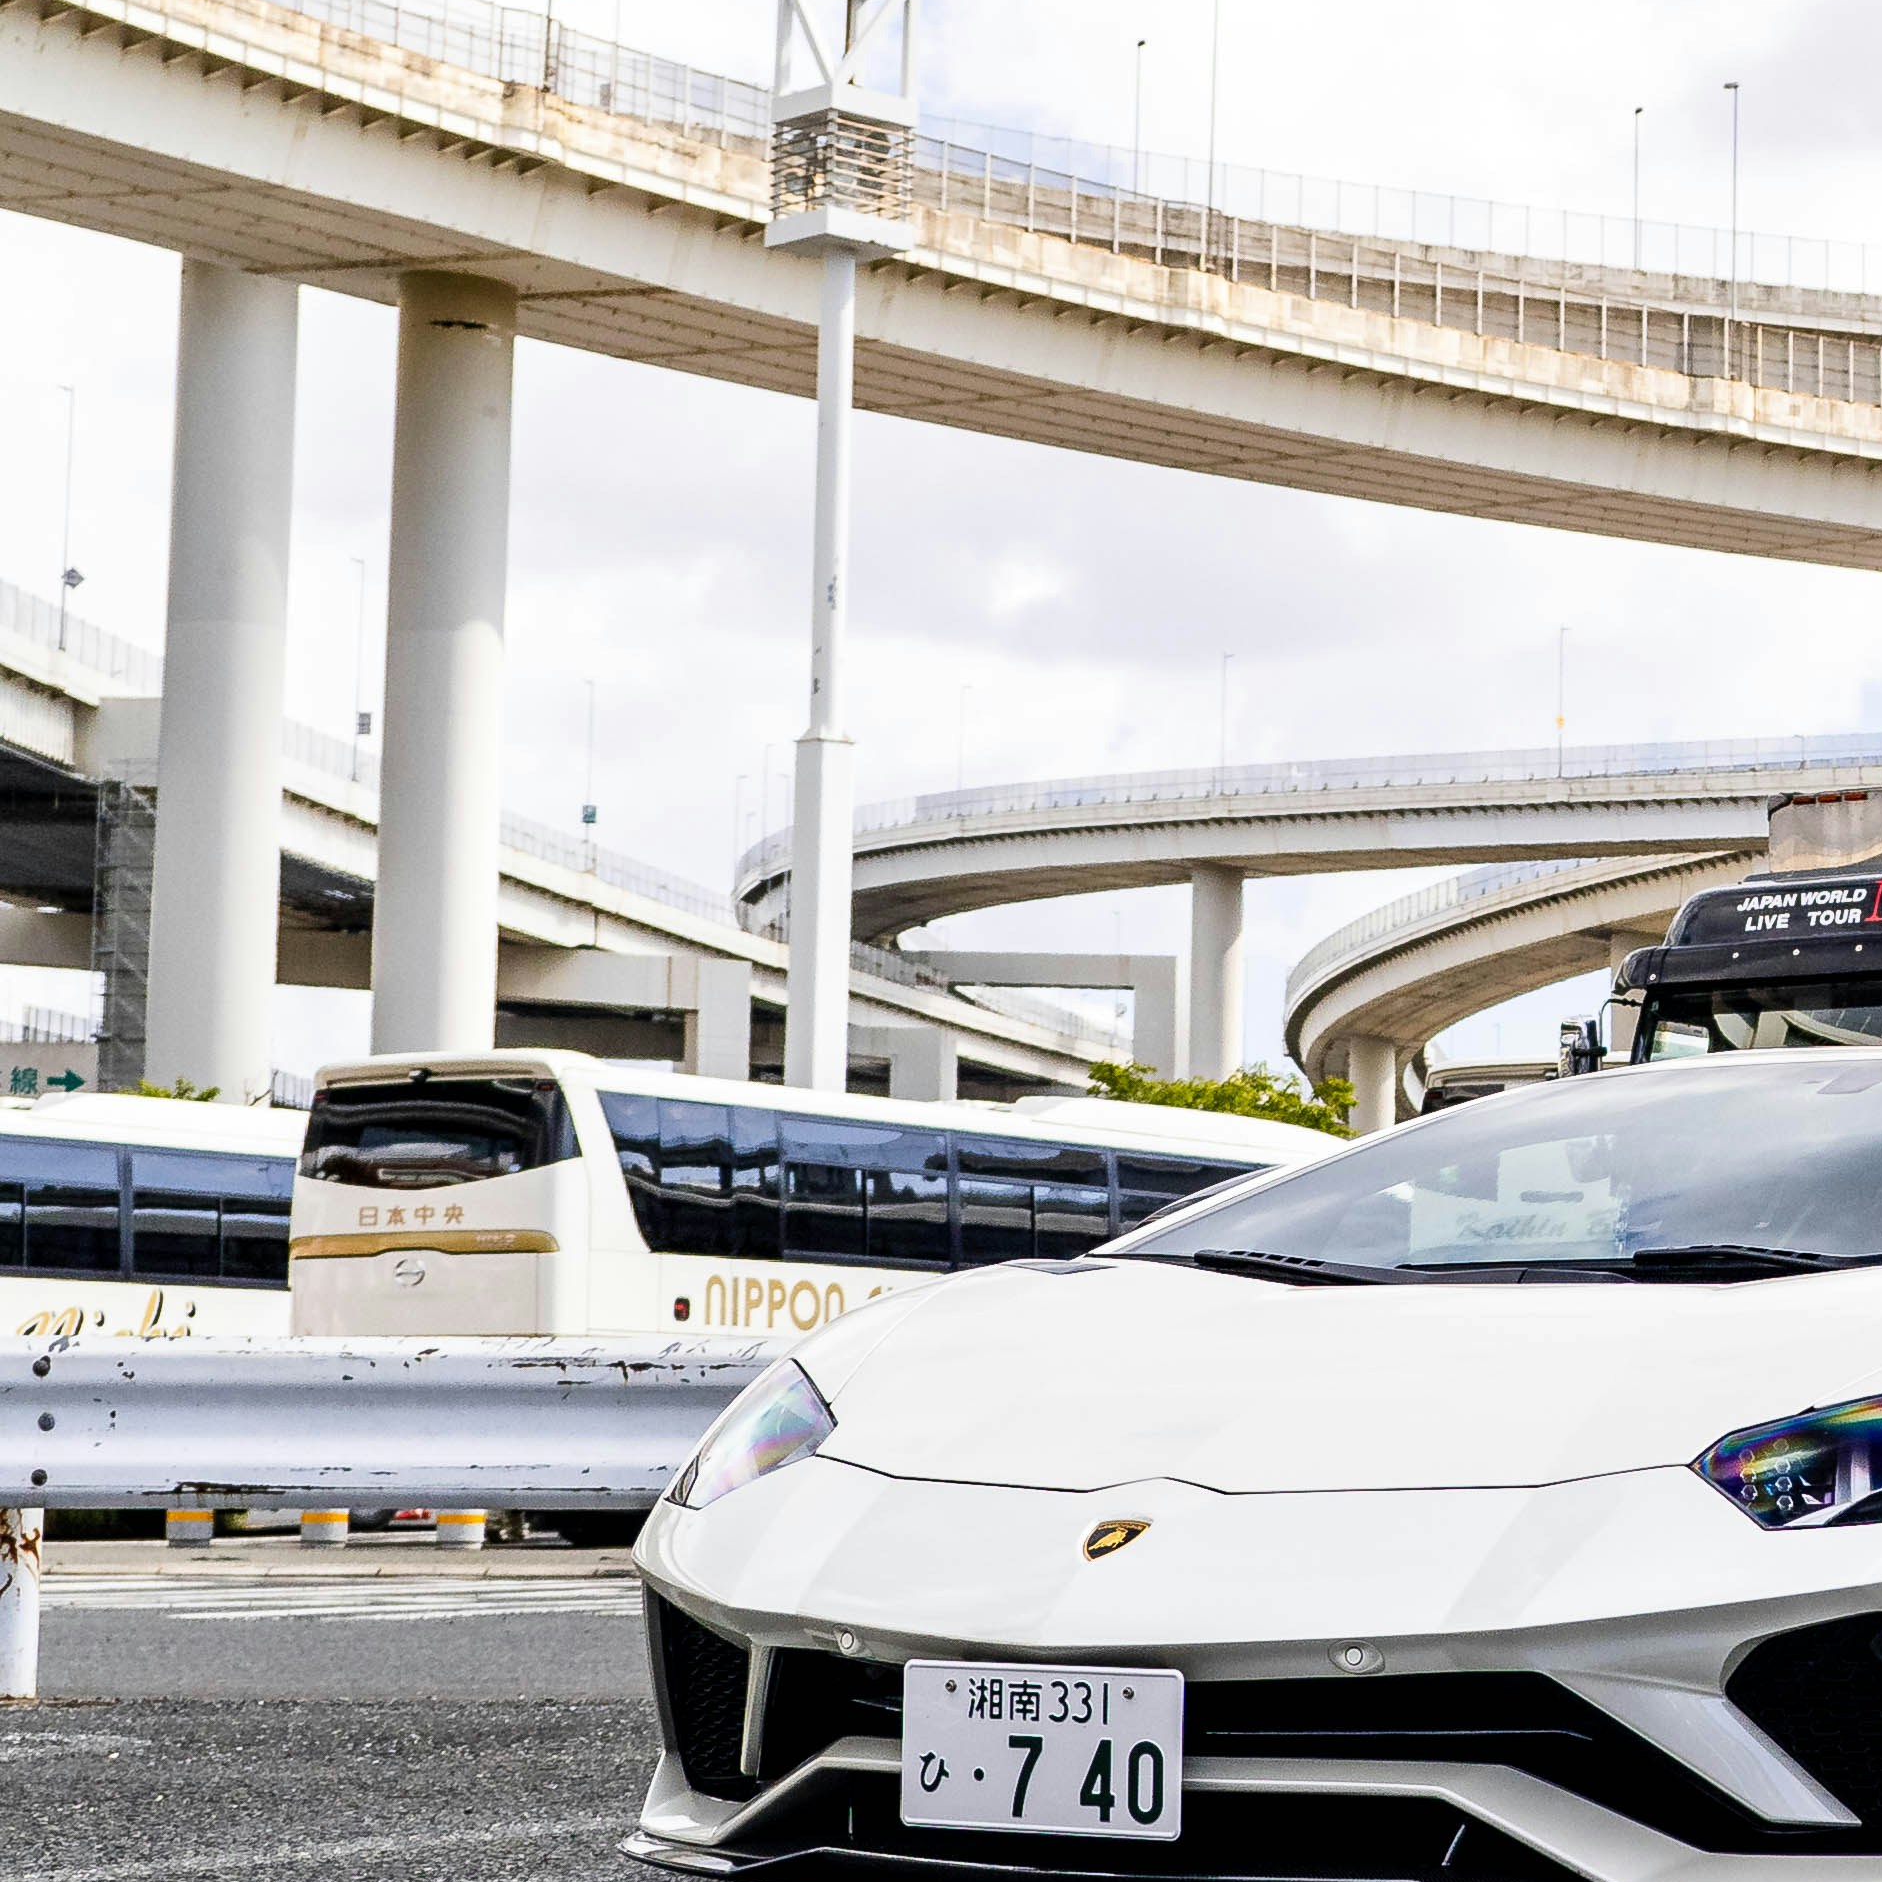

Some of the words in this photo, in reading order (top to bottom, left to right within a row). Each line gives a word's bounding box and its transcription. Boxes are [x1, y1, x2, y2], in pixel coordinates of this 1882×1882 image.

[1737, 894, 1797, 911] JAPAN
[1801, 888, 1867, 905] WORLD
[1745, 913, 1790, 931] LIVE
[1807, 909, 1861, 926] TOUR
[0, 1066, 38, 1094] 線
[358, 1204, 464, 1226] 日本中央
[705, 1274, 844, 1331] NIPPON
[919, 1751, 949, 1792] ひ
